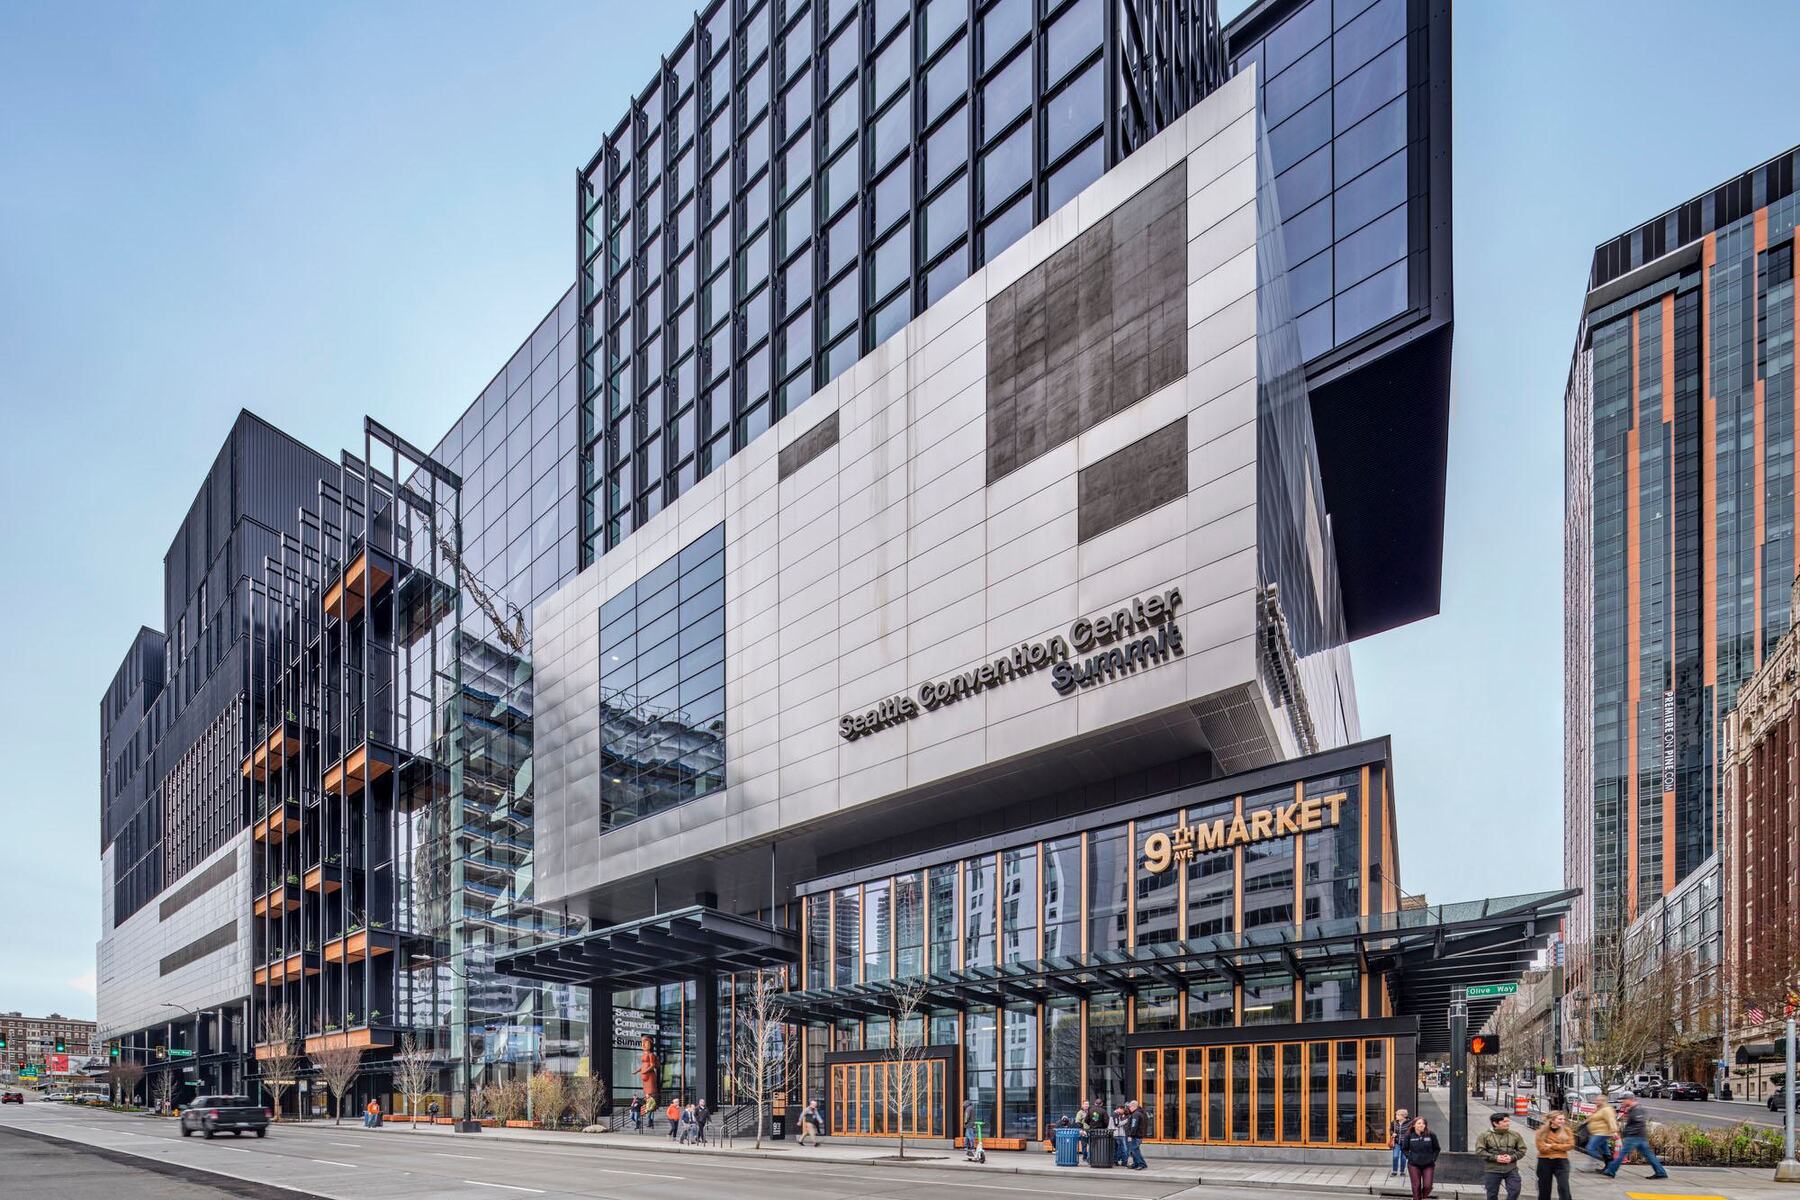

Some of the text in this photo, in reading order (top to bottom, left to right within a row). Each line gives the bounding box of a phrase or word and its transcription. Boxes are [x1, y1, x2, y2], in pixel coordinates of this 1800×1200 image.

[838, 585, 1183, 741] Seattle Convention Center
[1051, 622, 1184, 696] Summit
[1664, 691, 1674, 792] PREMIERE ON PINE.COM
[1144, 792, 1348, 873] 9 TH MARKET
[1173, 849, 1194, 861] AVE
[615, 1018, 660, 1030] Convention
